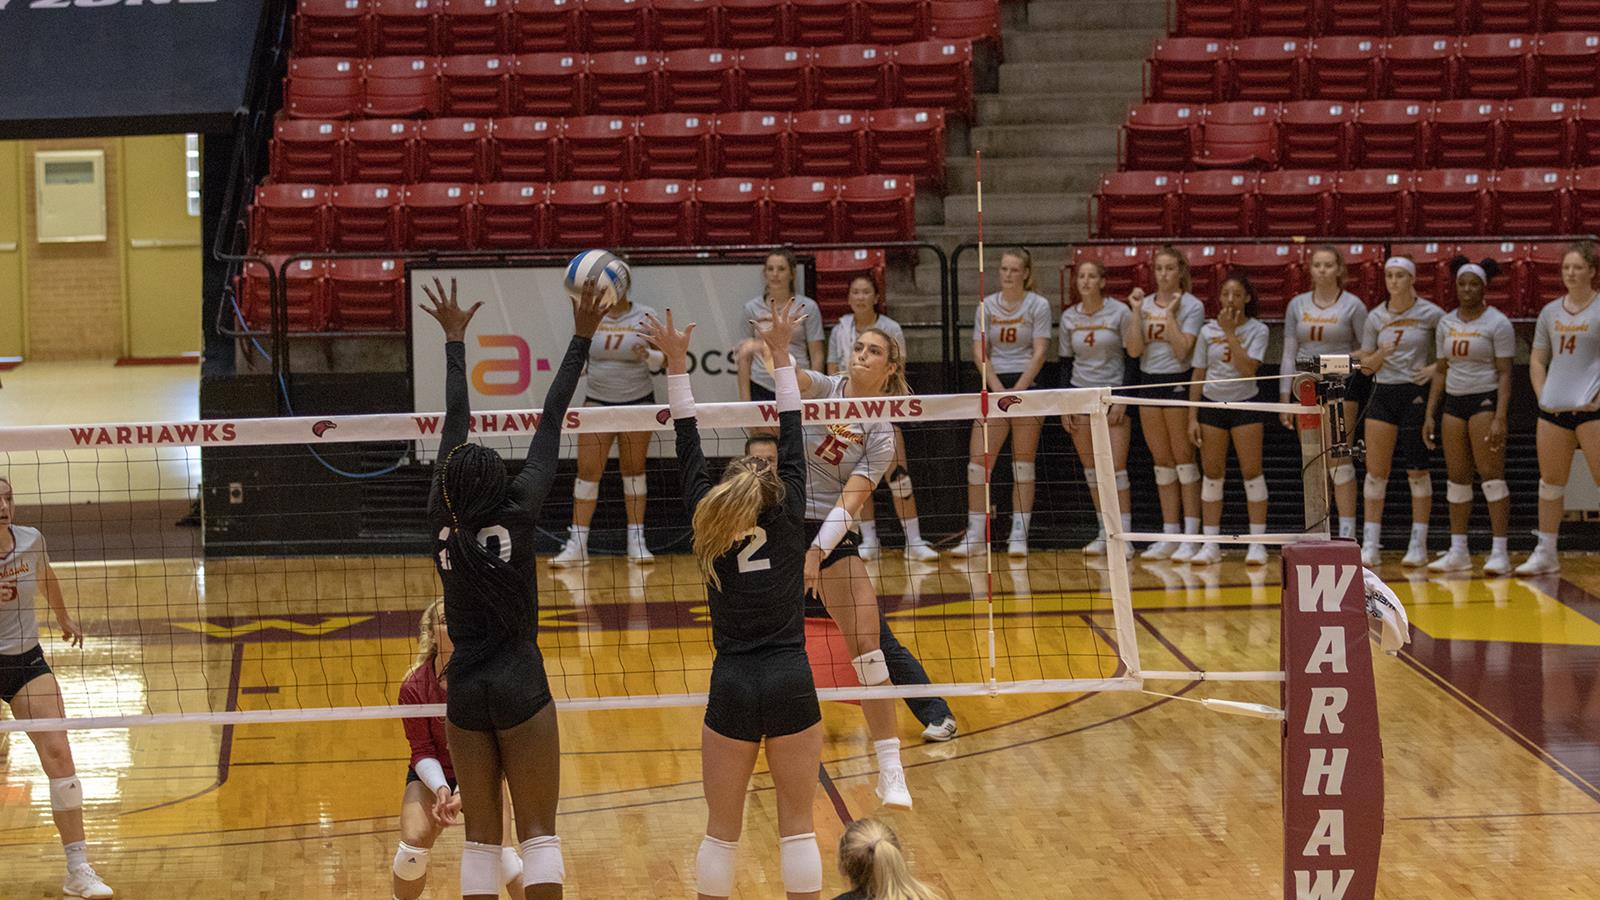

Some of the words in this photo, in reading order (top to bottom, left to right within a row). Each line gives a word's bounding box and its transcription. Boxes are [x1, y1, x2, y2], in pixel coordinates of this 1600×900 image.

[1001, 327, 1017, 343] 18
[1083, 331, 1096, 347] 4
[1148, 324, 1165, 340] 12
[1309, 326, 1324, 341] 11
[1394, 330, 1404, 347] 7
[604, 334, 624, 349] 17
[1452, 340, 1470, 357] 10
[1559, 335, 1577, 354] 14
[758, 399, 923, 422] WRHAWKS
[415, 411, 581, 434] WRHAWS
[69, 423, 236, 446] WARHAWKS
[814, 433, 849, 466] 15
[736, 526, 772, 573] 2
